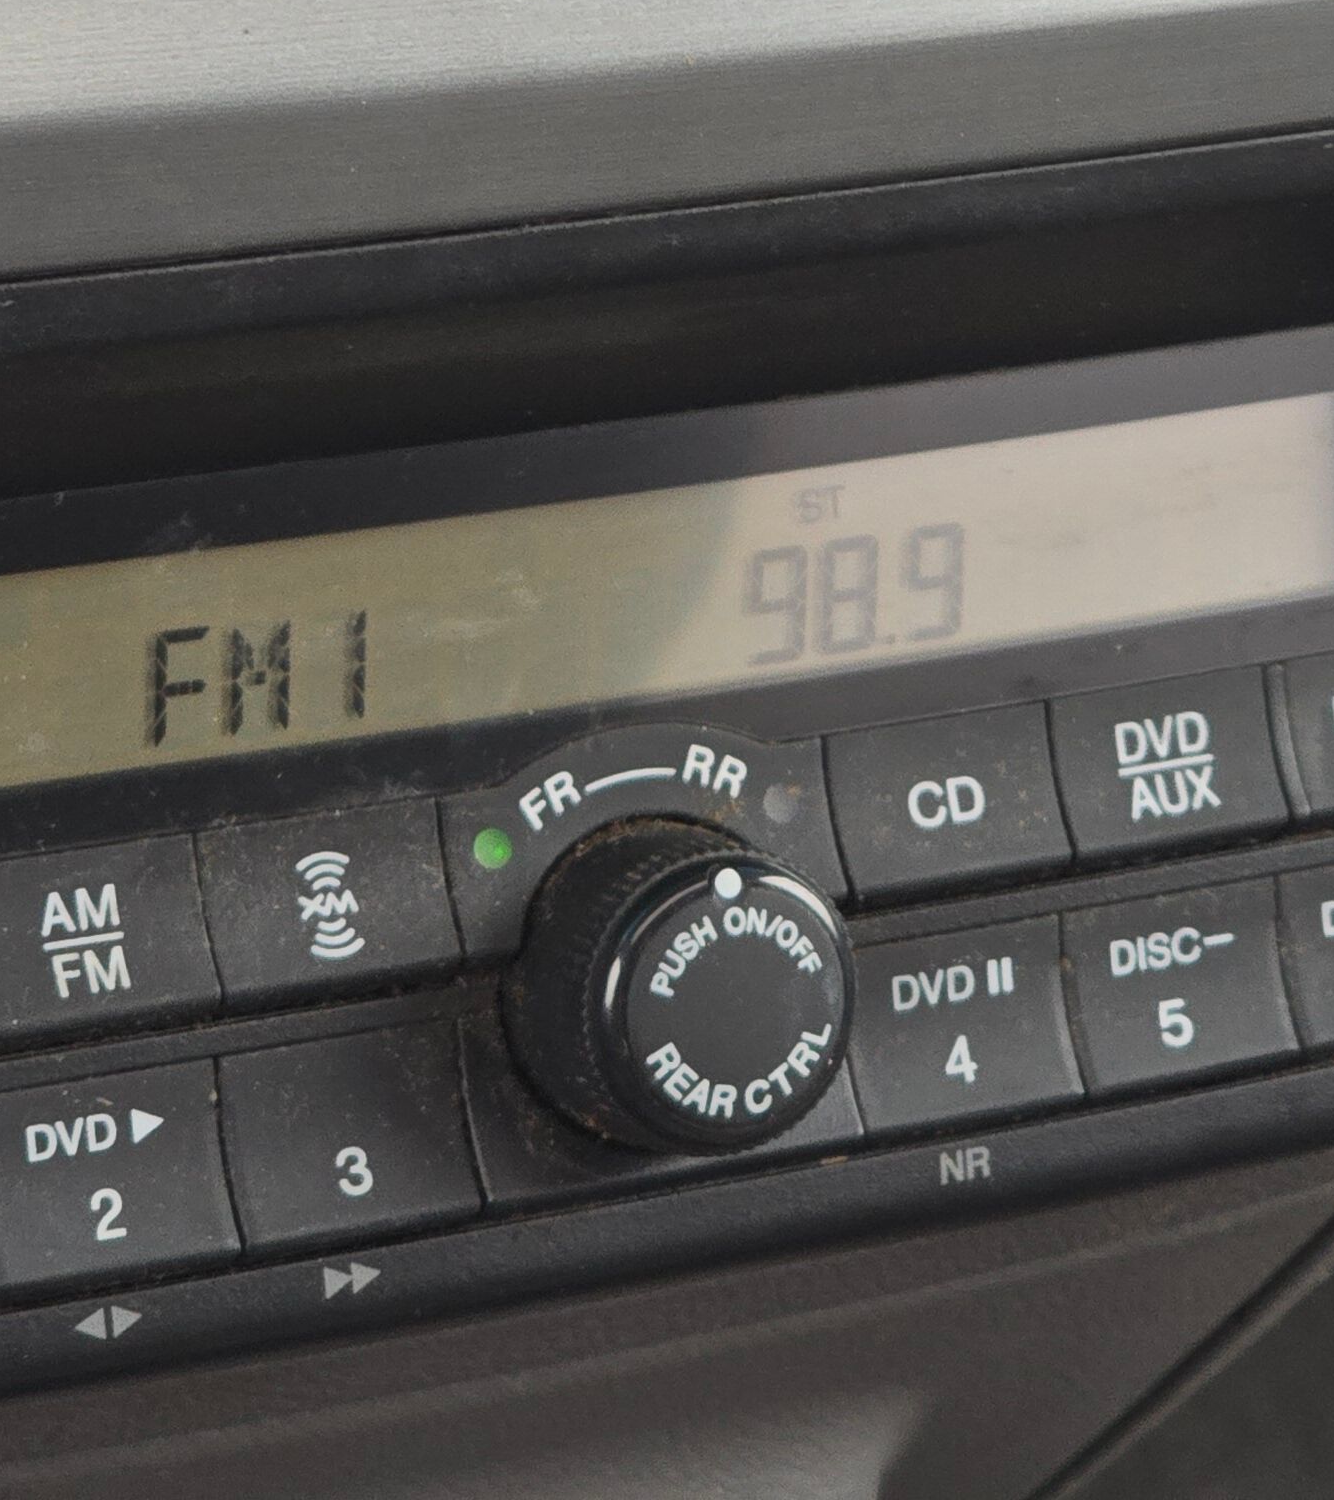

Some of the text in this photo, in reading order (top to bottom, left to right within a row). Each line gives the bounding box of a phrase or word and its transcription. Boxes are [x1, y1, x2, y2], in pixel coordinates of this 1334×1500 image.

[743, 520, 966, 666] 98.9
[1114, 710, 1210, 764] DVD
[518, 743, 749, 832] FR RR
[906, 774, 986, 829] CD
[1129, 770, 1222, 821] AUX
[40, 882, 121, 938] AM
[296, 888, 360, 925] XM
[51, 946, 132, 999] FM
[649, 903, 823, 998] PUSH ON/OFF
[891, 964, 976, 1013] DVD
[1157, 997, 1195, 1049] 5
[645, 1022, 833, 1119] REAR CTRL
[944, 1033, 979, 1084] 4
[24, 1112, 118, 1164] DVD
[334, 1145, 375, 1198] 3
[939, 1145, 992, 1185] NR
[89, 1187, 128, 1242] 2
